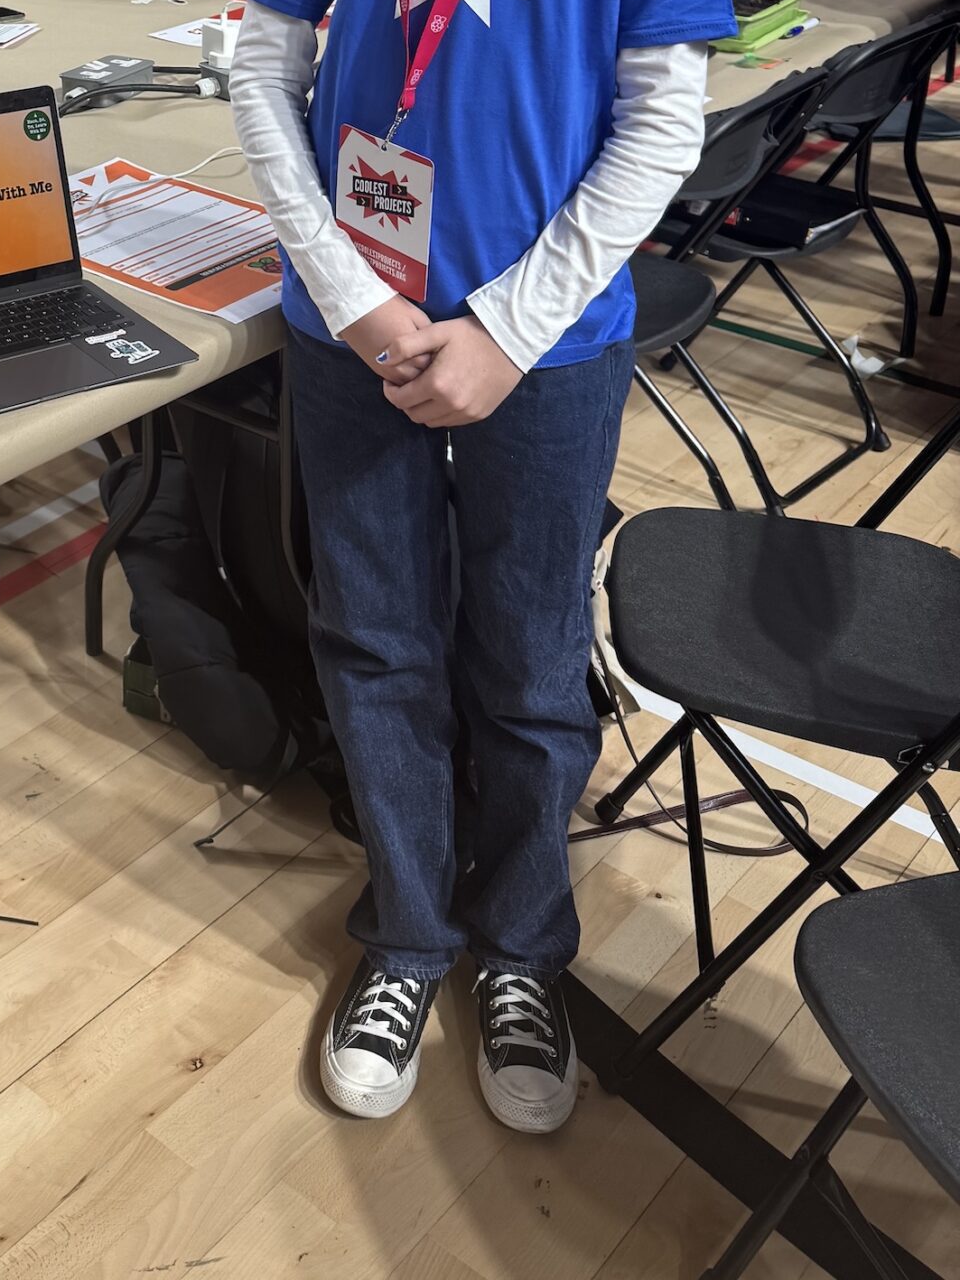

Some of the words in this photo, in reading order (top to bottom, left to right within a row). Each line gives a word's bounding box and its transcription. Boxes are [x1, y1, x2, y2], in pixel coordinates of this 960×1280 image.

[29, 181, 53, 195] Me
[354, 178, 388, 196] COOLEST
[374, 195, 412, 214] PROJECTS
